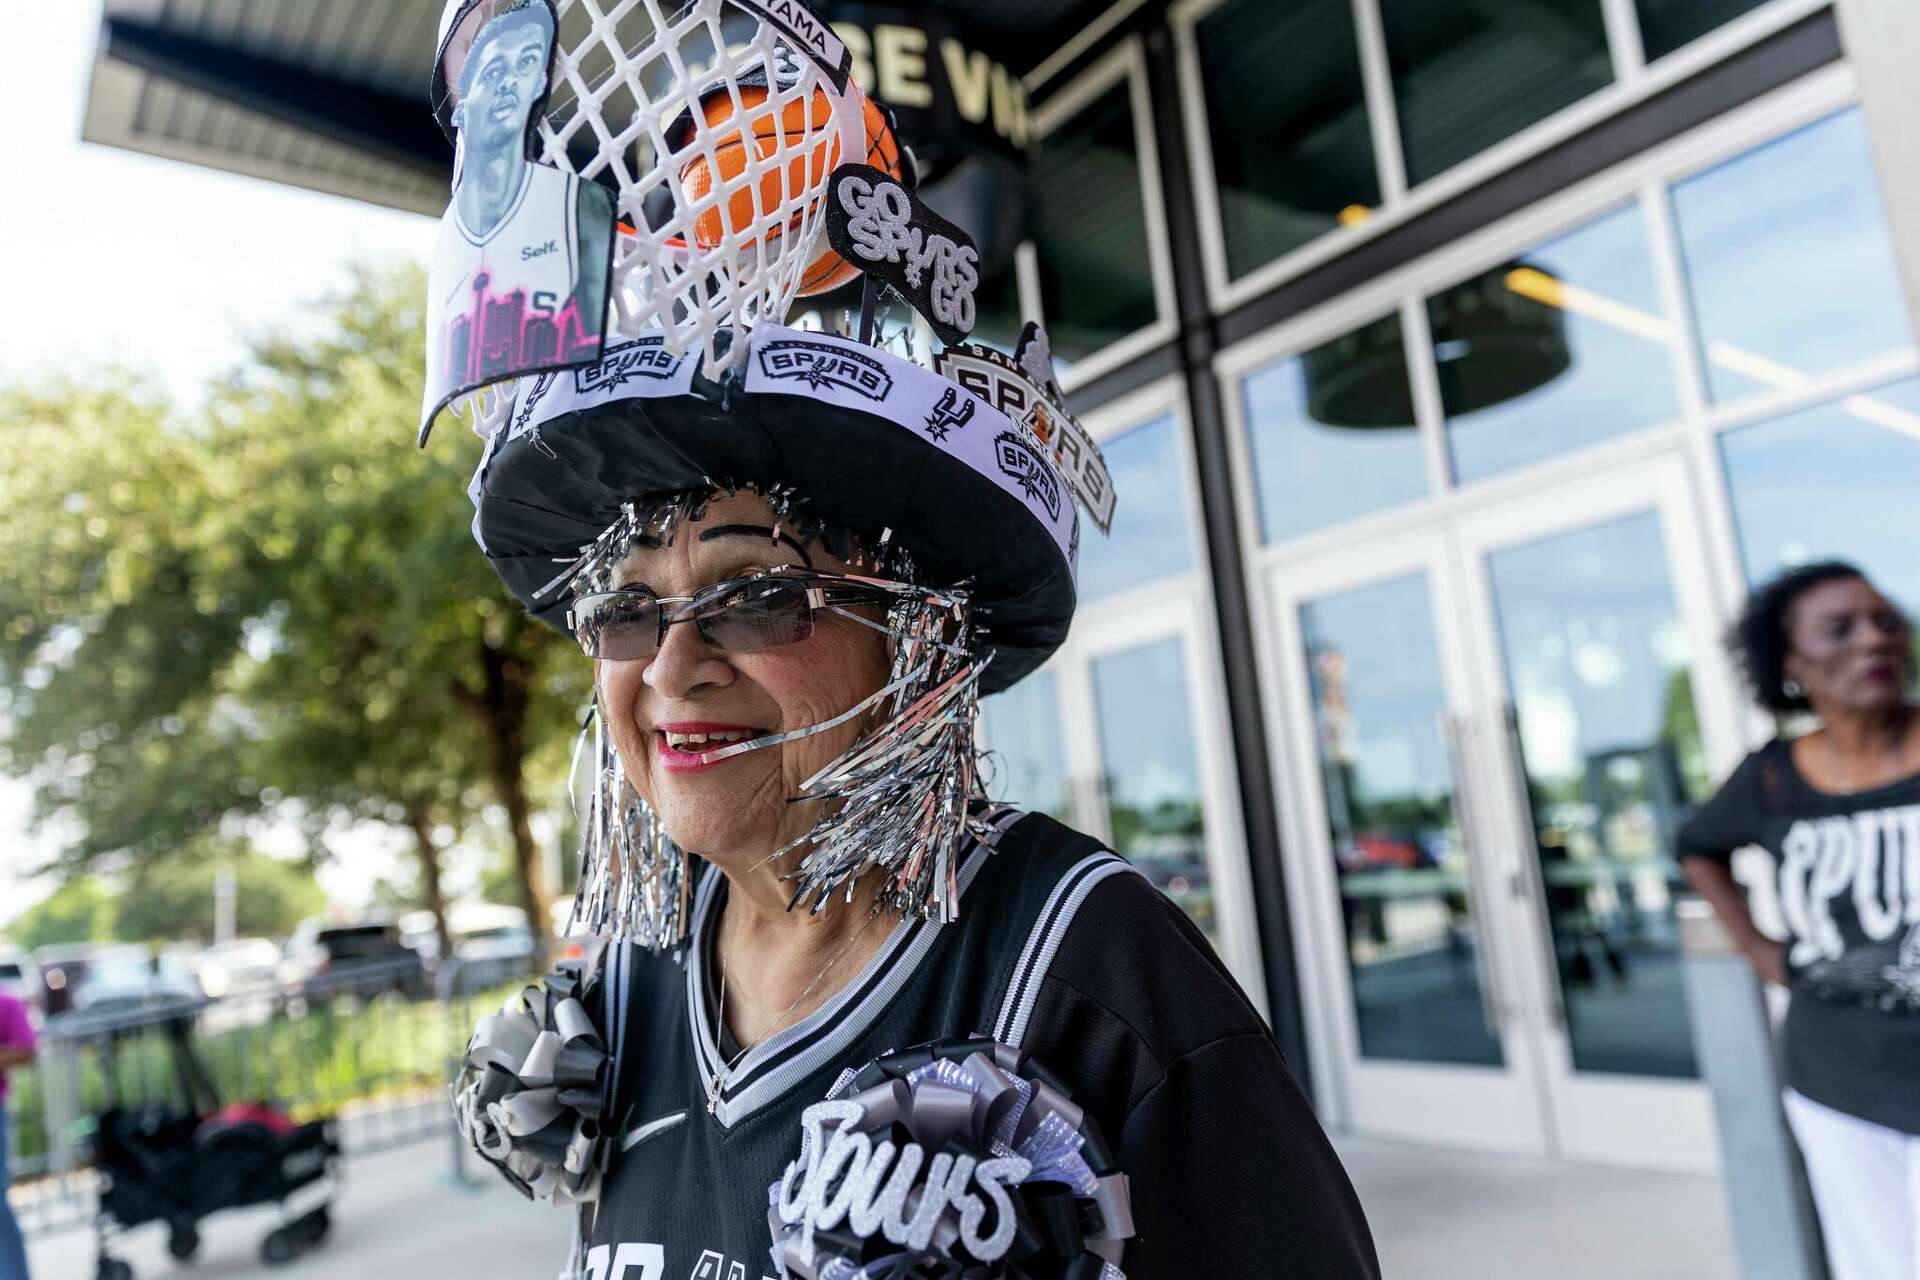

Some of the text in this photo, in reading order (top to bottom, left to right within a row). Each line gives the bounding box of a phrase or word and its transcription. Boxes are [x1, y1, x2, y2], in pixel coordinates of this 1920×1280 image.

[838, 176, 912, 226] GO
[521, 240, 559, 261] Self.
[847, 217, 979, 291] SPURS
[931, 278, 977, 333] GO
[585, 349, 674, 386] SPURS
[771, 352, 881, 391] SPURS
[971, 345, 1018, 371] SAN
[1003, 445, 1057, 511] SPURS
